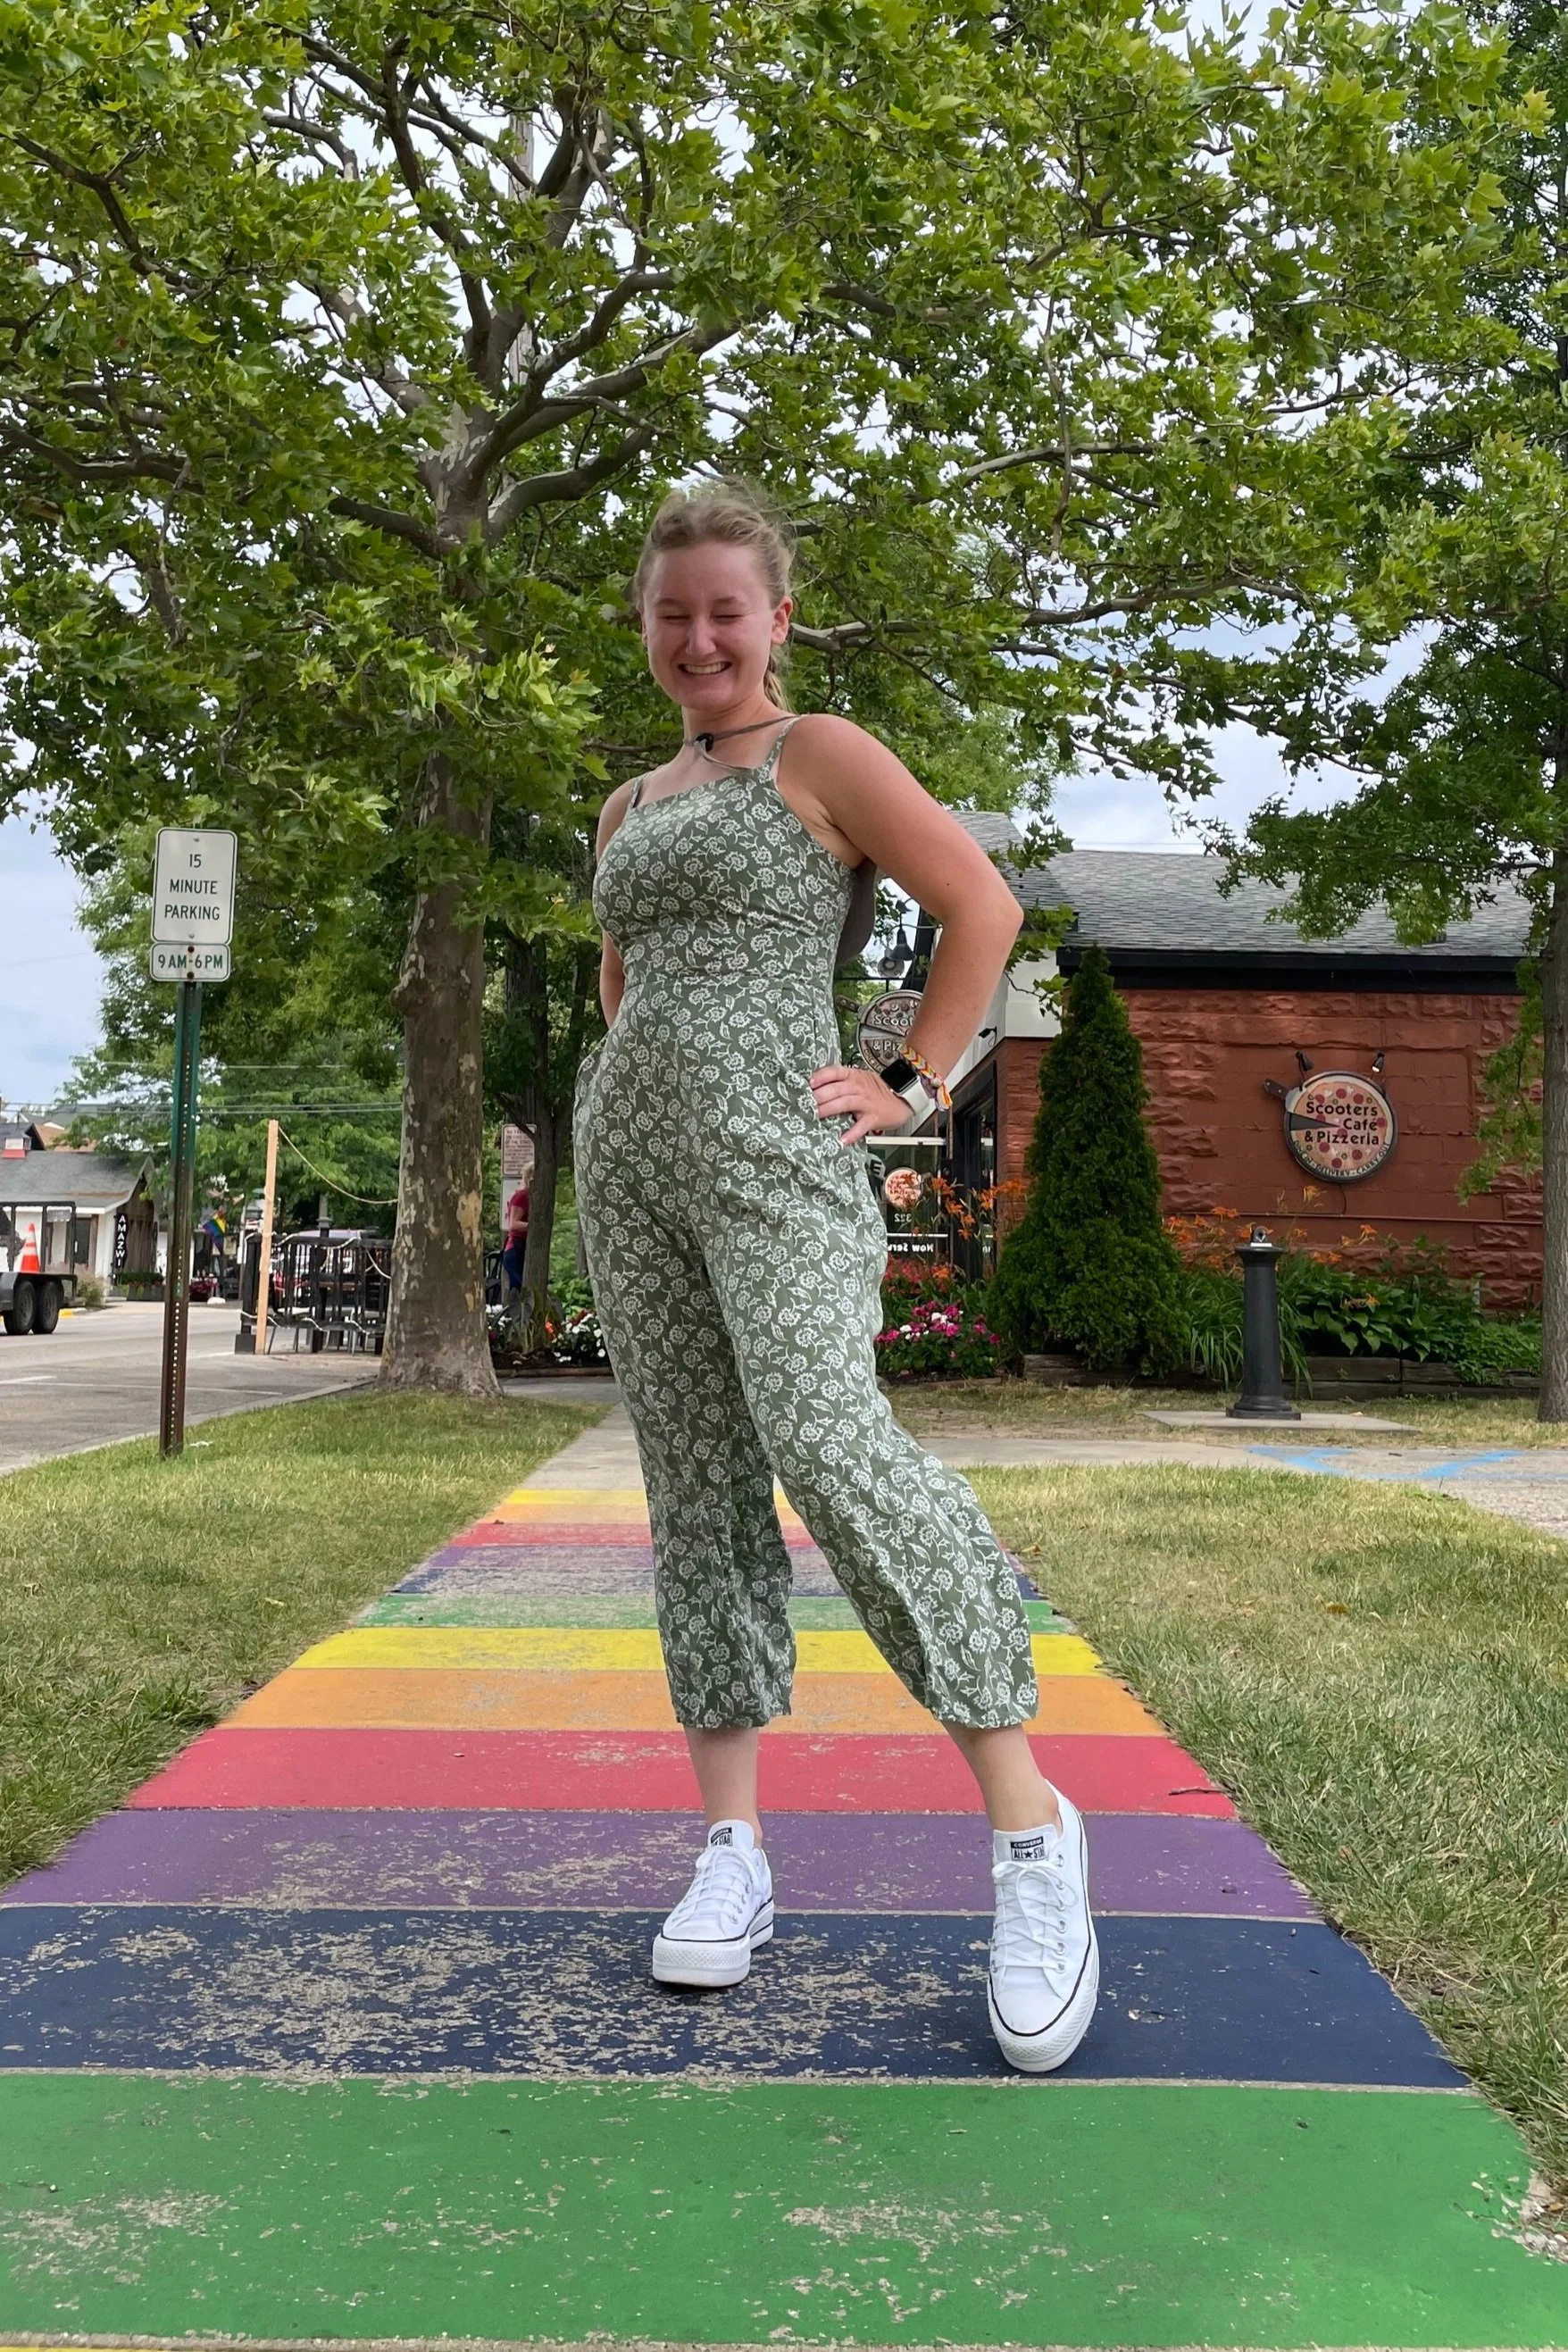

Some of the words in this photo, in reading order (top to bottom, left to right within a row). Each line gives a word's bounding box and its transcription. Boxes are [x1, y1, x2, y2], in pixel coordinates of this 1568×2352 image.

[189, 854, 202, 868] 15
[170, 879, 218, 895] MINUTE
[164, 904, 221, 921] PARKING
[872, 1040, 880, 1051] &
[1306, 1101, 1378, 1116] Scooters
[1343, 1117, 1378, 1131] Café
[1305, 1130, 1314, 1143] &
[1316, 1130, 1380, 1146] Pizzeria
[1356, 1158, 1380, 1174] CARRY
[1379, 1143, 1390, 1158] OUT
[115, 1214, 126, 1266] AMAZWI
